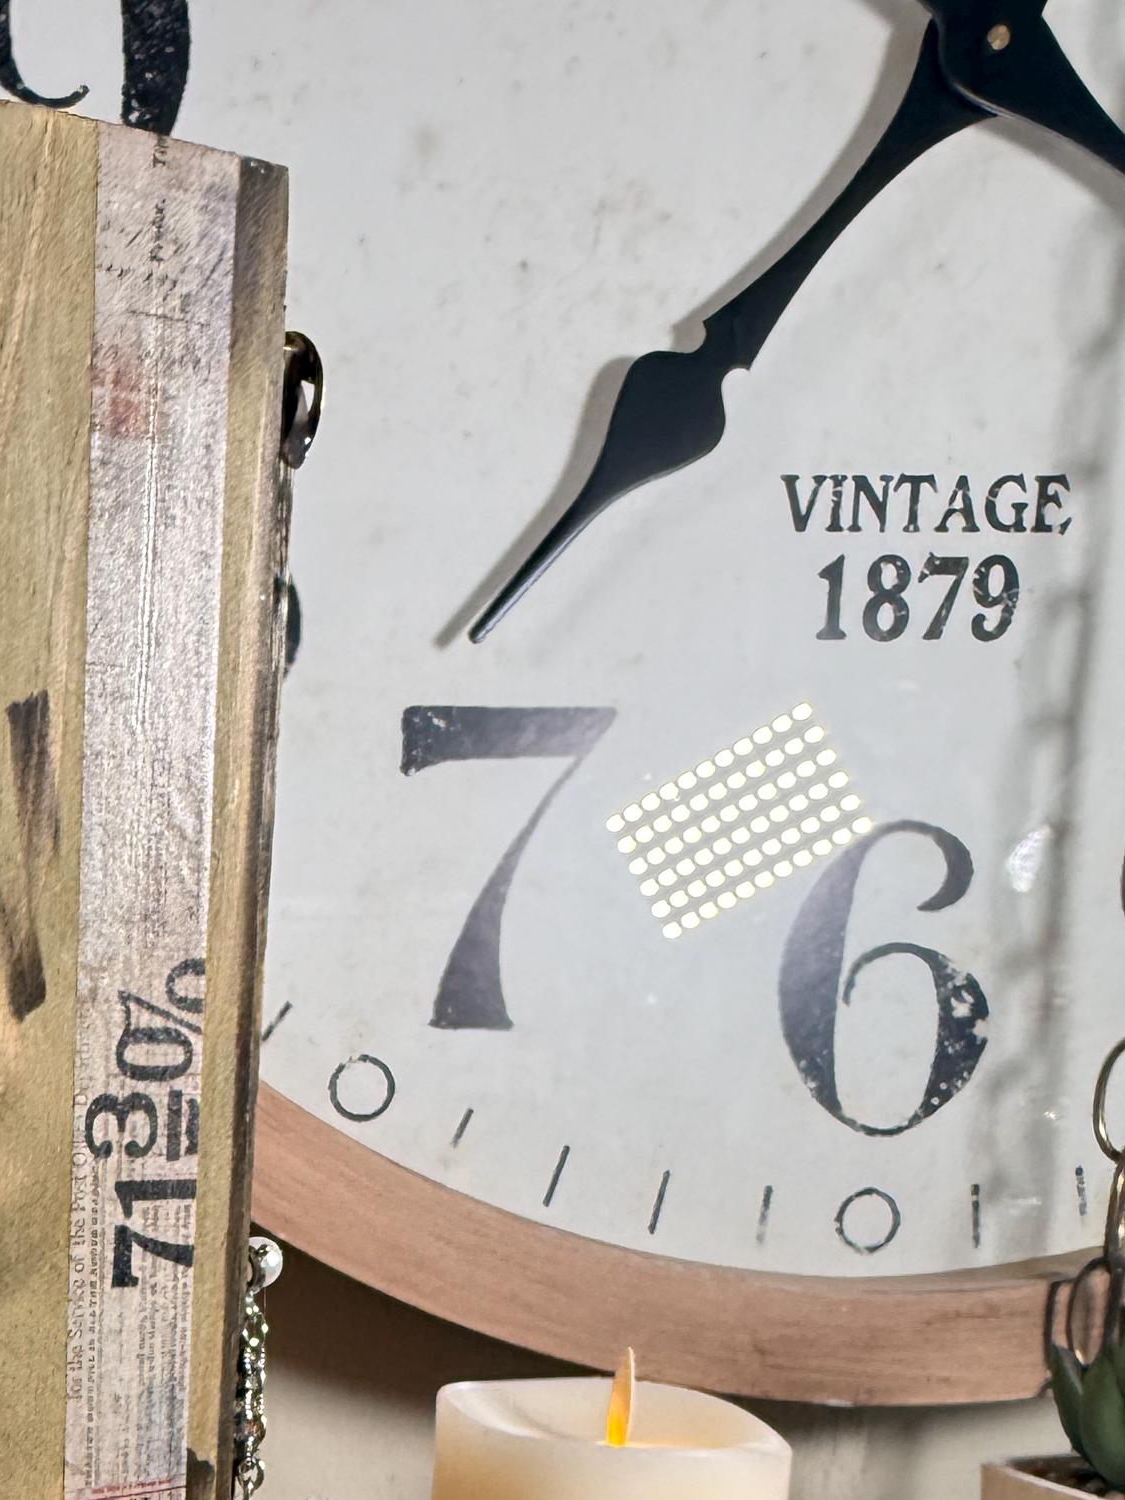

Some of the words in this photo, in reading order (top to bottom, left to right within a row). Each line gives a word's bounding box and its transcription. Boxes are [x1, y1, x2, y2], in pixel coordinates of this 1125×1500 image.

[781, 473, 1072, 536] VINTAGE
[816, 553, 1021, 642] 1879
[401, 706, 617, 1031] 7
[778, 819, 990, 1137] 6
